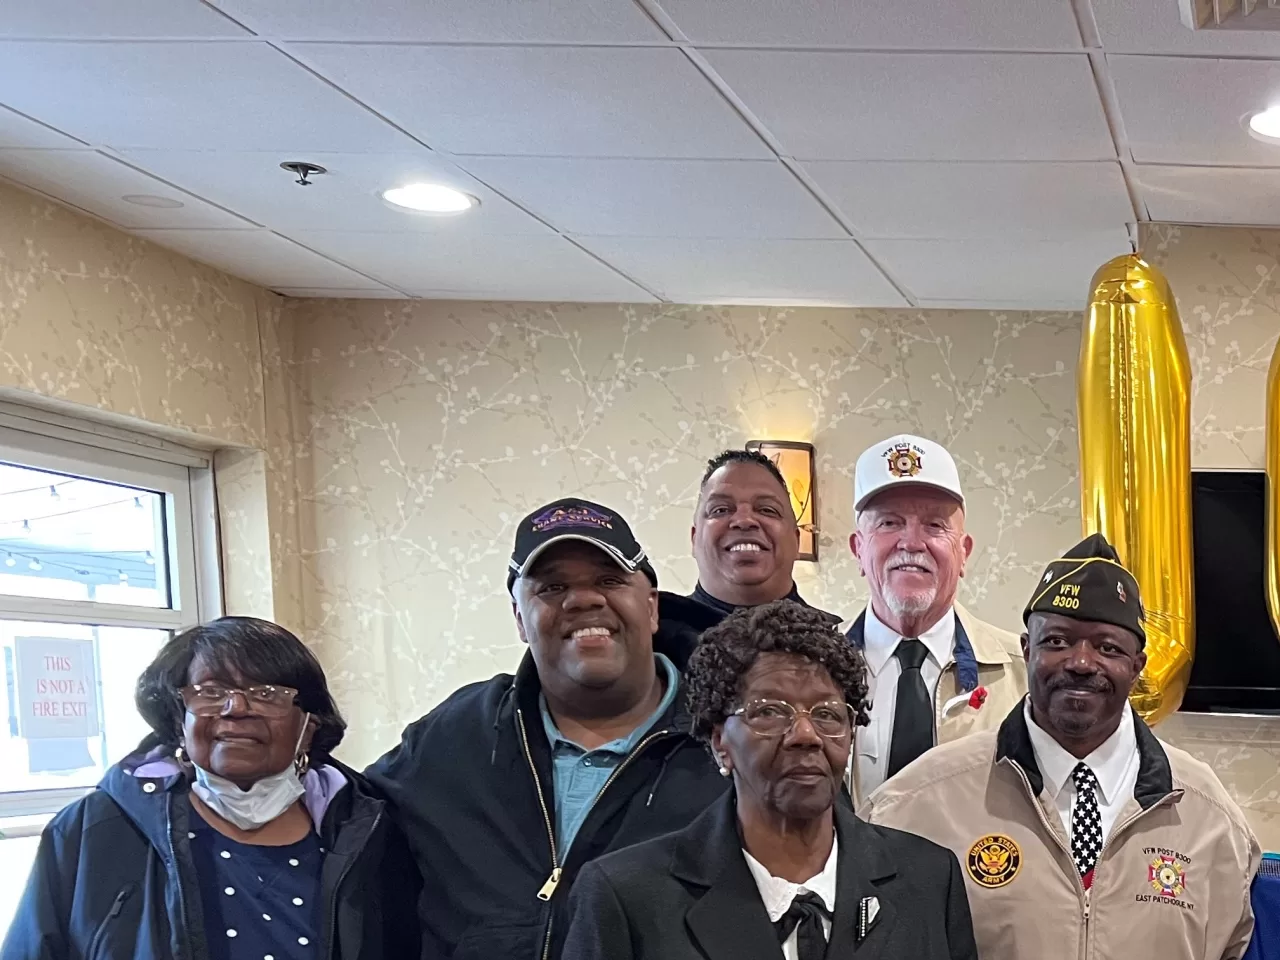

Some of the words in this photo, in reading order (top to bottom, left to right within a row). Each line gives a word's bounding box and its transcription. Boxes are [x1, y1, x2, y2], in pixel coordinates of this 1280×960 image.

[1059, 583, 1081, 596] VFW
[1052, 595, 1080, 609] 8300
[43, 655, 72, 672] THIS
[36, 678, 48, 694] IS
[49, 679, 75, 695] NOT
[77, 680, 86, 694] A
[32, 701, 60, 717] FIRE
[61, 701, 89, 717] EXIT
[970, 837, 994, 857] UNITED
[997, 837, 1018, 857] STATES
[1142, 847, 1156, 855] VFW
[1157, 847, 1175, 856] POST
[1175, 851, 1192, 864] 8300
[1135, 894, 1152, 902] EAST
